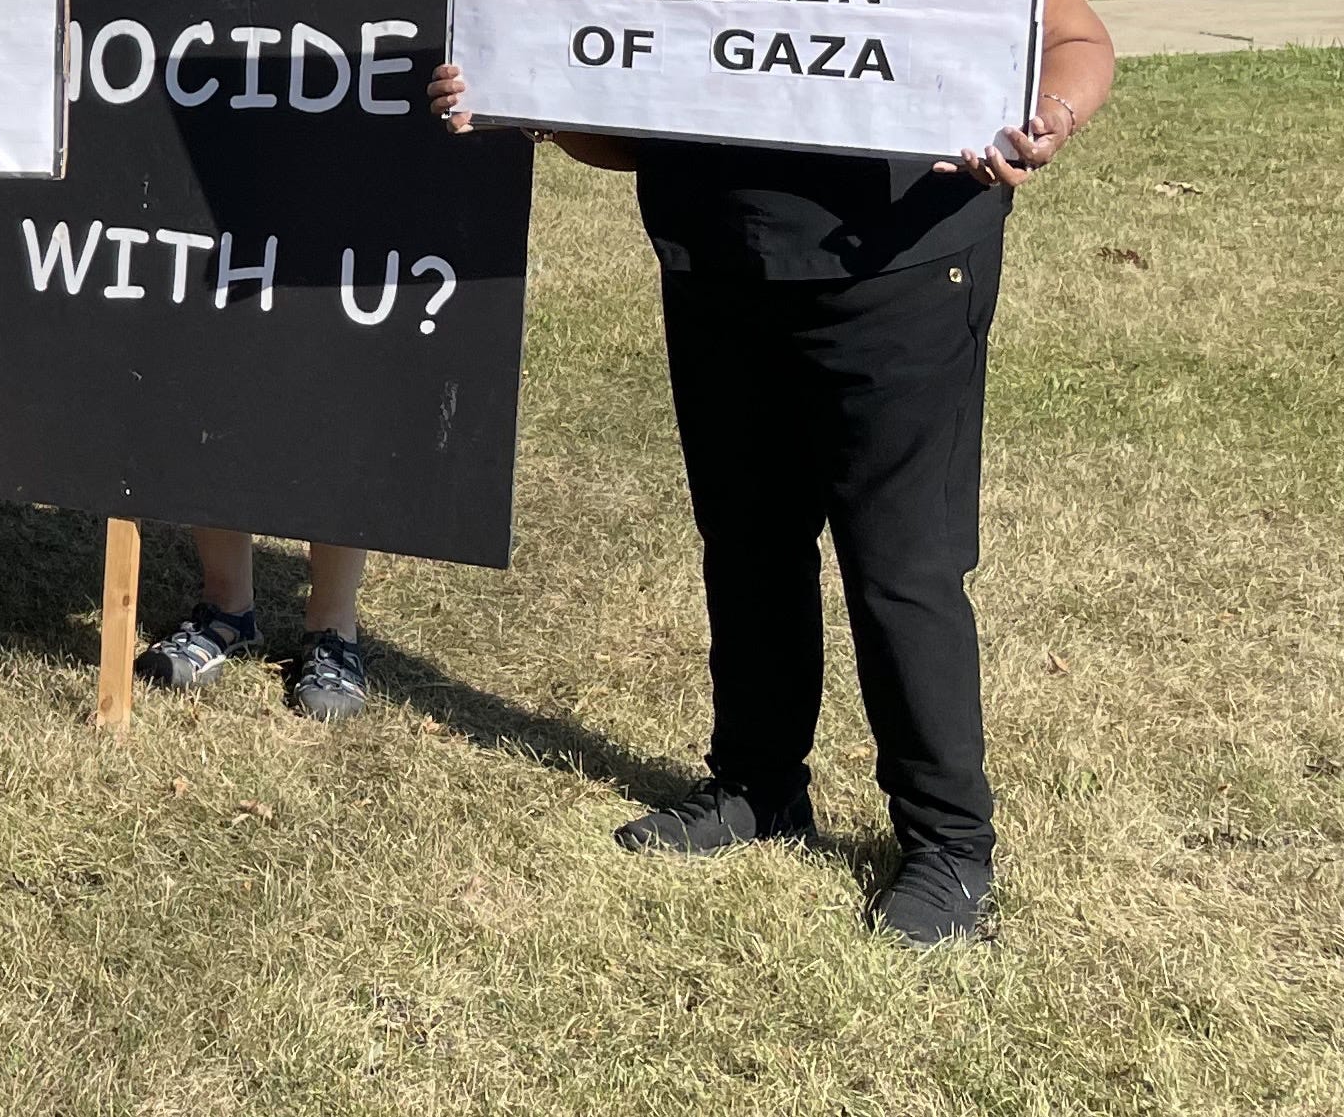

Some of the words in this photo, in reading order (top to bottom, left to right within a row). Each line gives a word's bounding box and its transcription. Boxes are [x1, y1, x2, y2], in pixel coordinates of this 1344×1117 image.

[69, 19, 419, 115] OCIDE
[572, 25, 655, 69] OF
[713, 29, 895, 82] GAZA
[22, 218, 279, 312] WITH
[340, 247, 458, 335] U?
